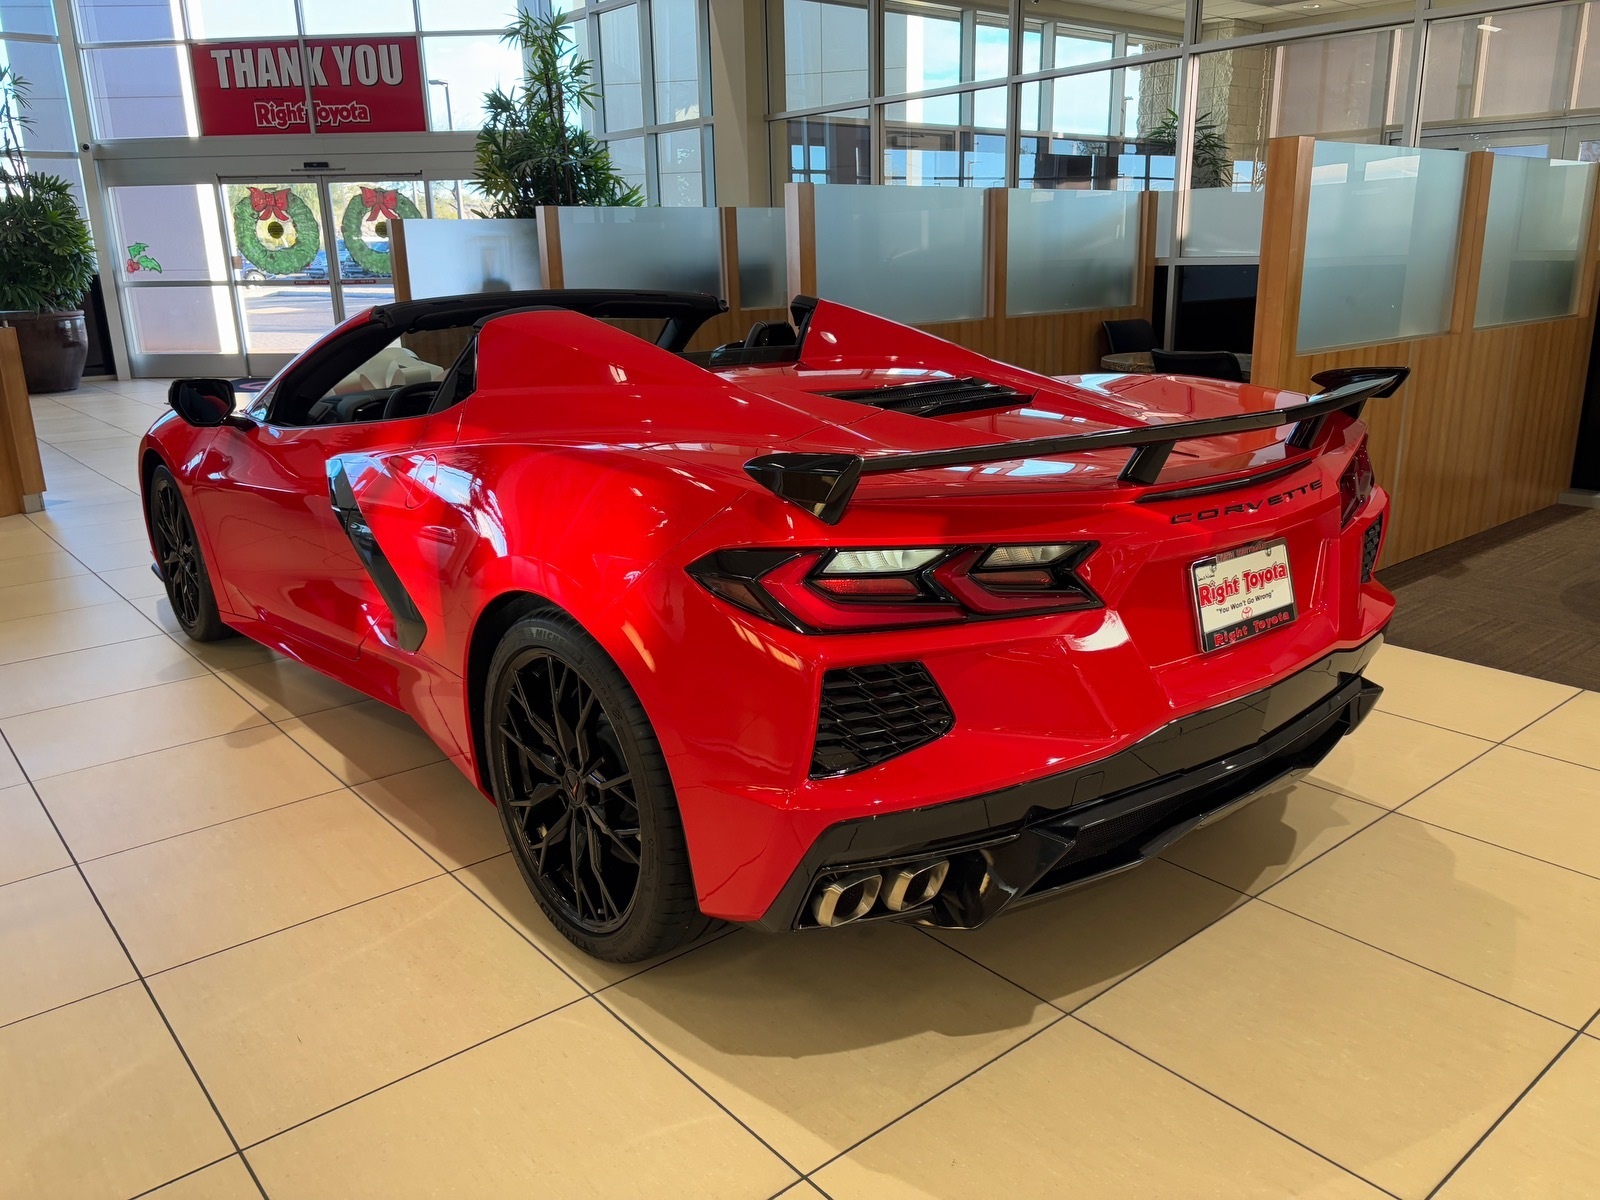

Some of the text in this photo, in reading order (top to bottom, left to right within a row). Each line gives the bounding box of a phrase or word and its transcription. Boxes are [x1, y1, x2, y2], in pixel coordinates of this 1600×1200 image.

[210, 44, 404, 89] THANK YOU
[253, 101, 307, 130] Right
[1171, 479, 1323, 525] CORVETTE
[1198, 561, 1288, 608] Right Toyota
[1230, 600, 1247, 611] Won't
[1247, 597, 1255, 605] Go
[1213, 611, 1290, 647] Right Toyota
